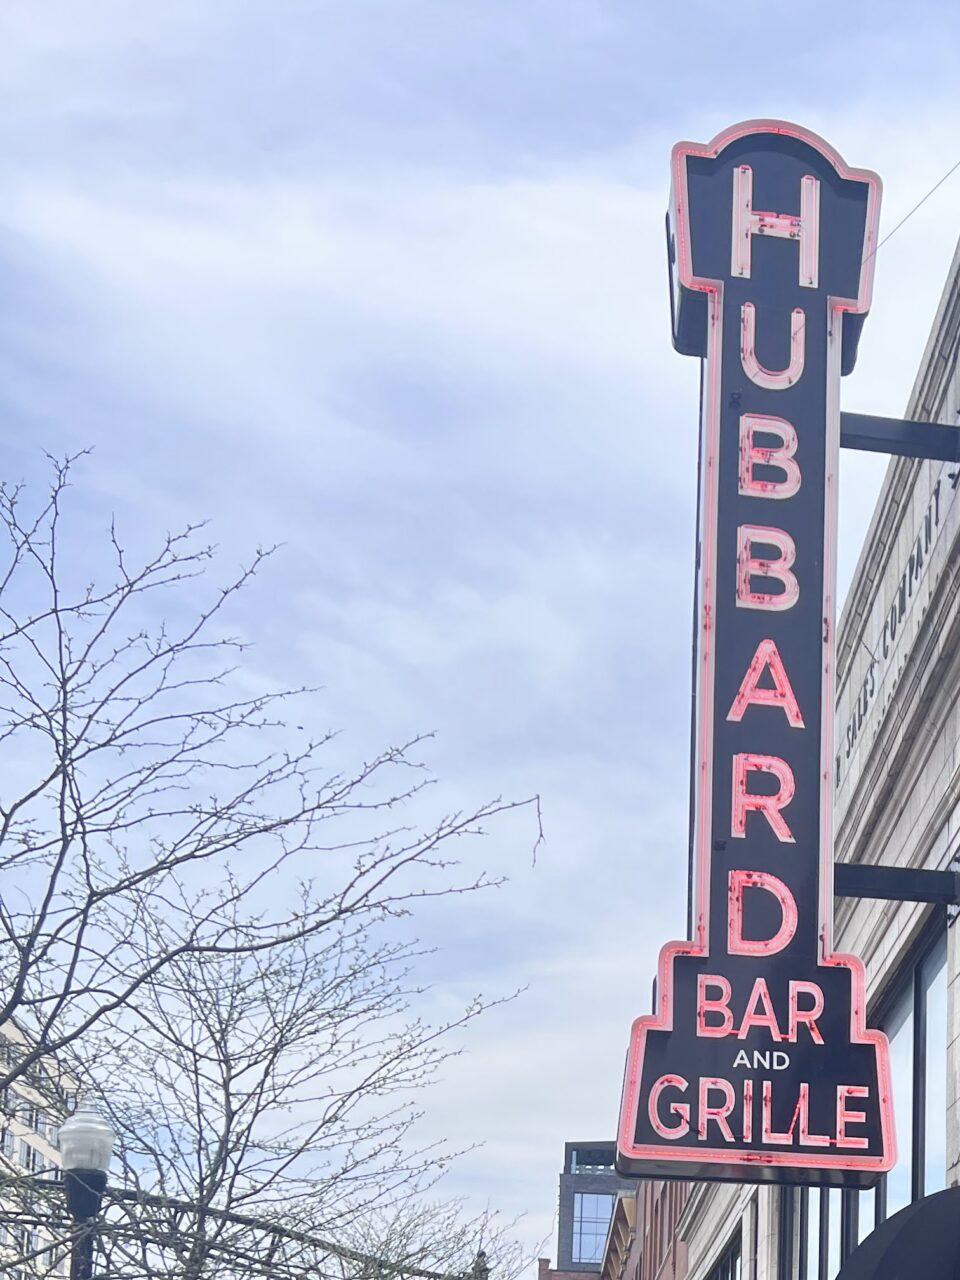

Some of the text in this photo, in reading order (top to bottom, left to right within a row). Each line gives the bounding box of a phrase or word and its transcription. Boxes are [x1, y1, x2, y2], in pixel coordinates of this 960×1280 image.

[726, 164, 821, 959] HUBBARD
[883, 479, 941, 660] COMPANY
[696, 973, 825, 1046] BAR
[732, 1049, 790, 1071] AND
[647, 1073, 869, 1150] GRILLE
